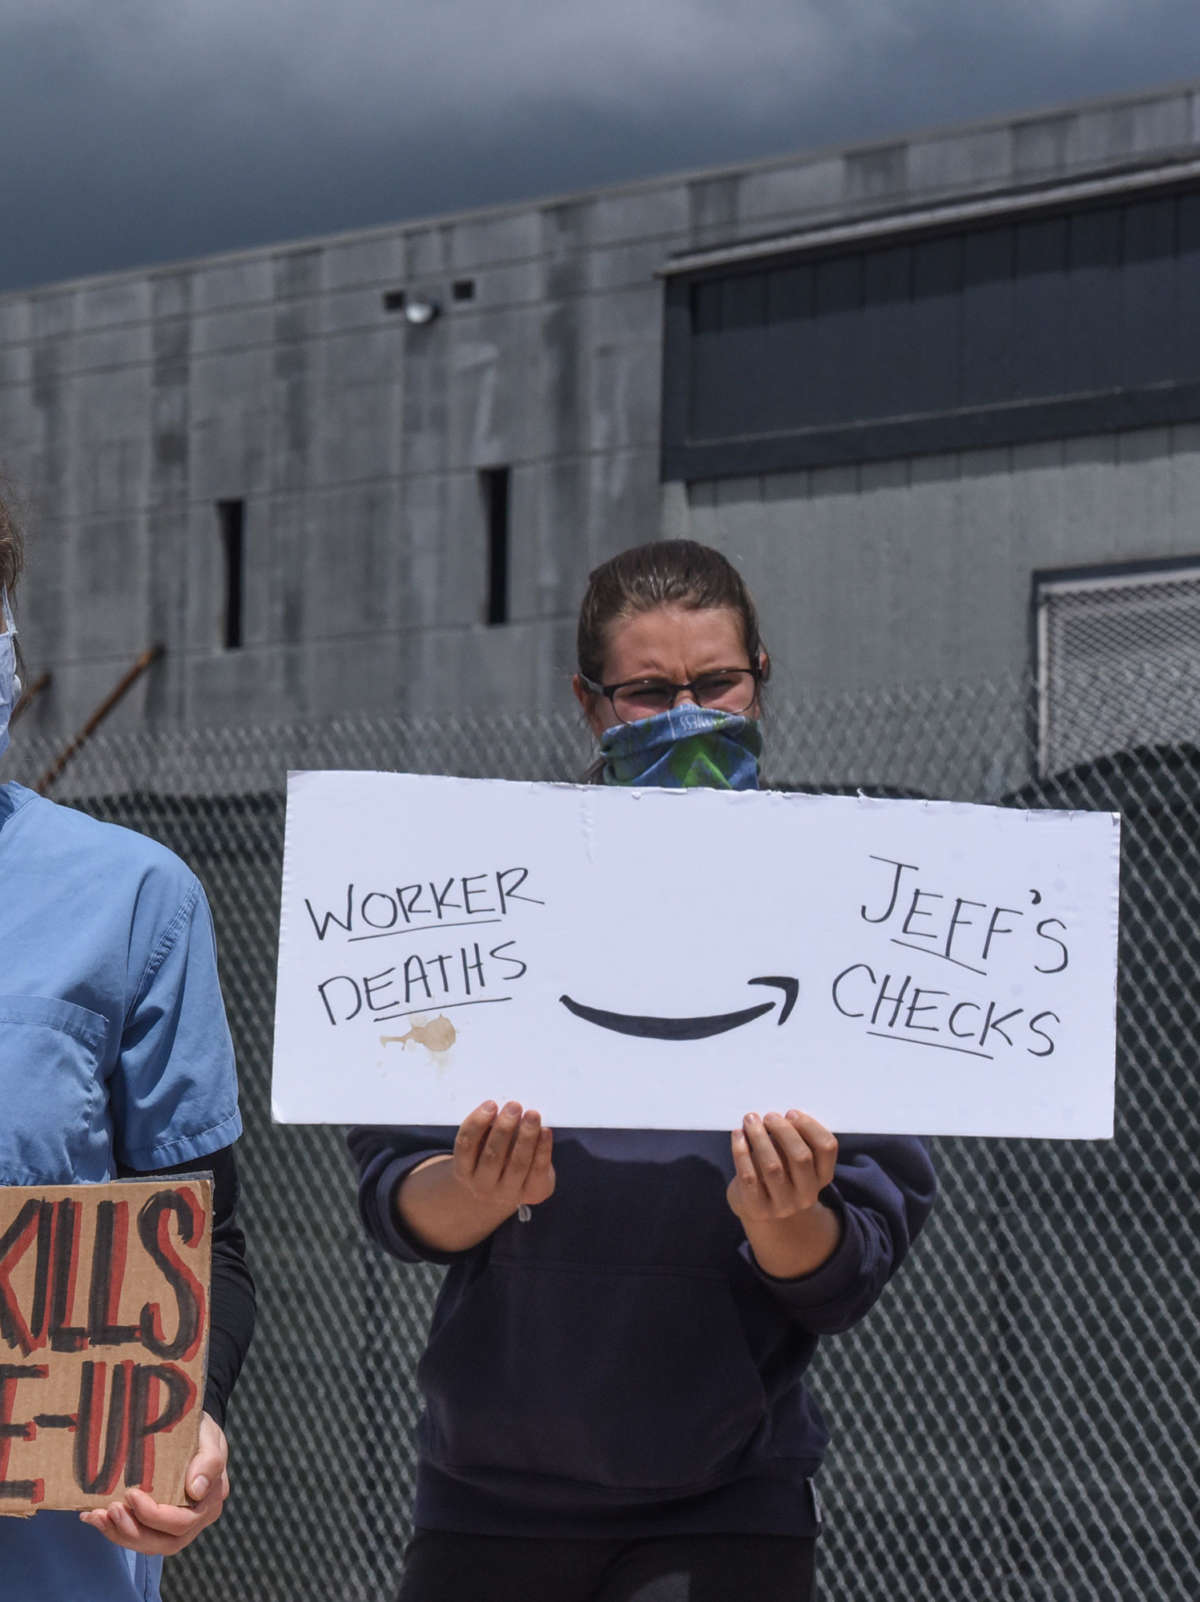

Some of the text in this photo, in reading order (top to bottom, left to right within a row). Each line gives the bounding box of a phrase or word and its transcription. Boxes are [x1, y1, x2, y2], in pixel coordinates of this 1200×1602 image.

[303, 866, 546, 942] WORKER
[860, 854, 1070, 974] JEFF'S
[316, 939, 529, 1025] DEATHS
[830, 963, 1062, 1057] CHECKS
